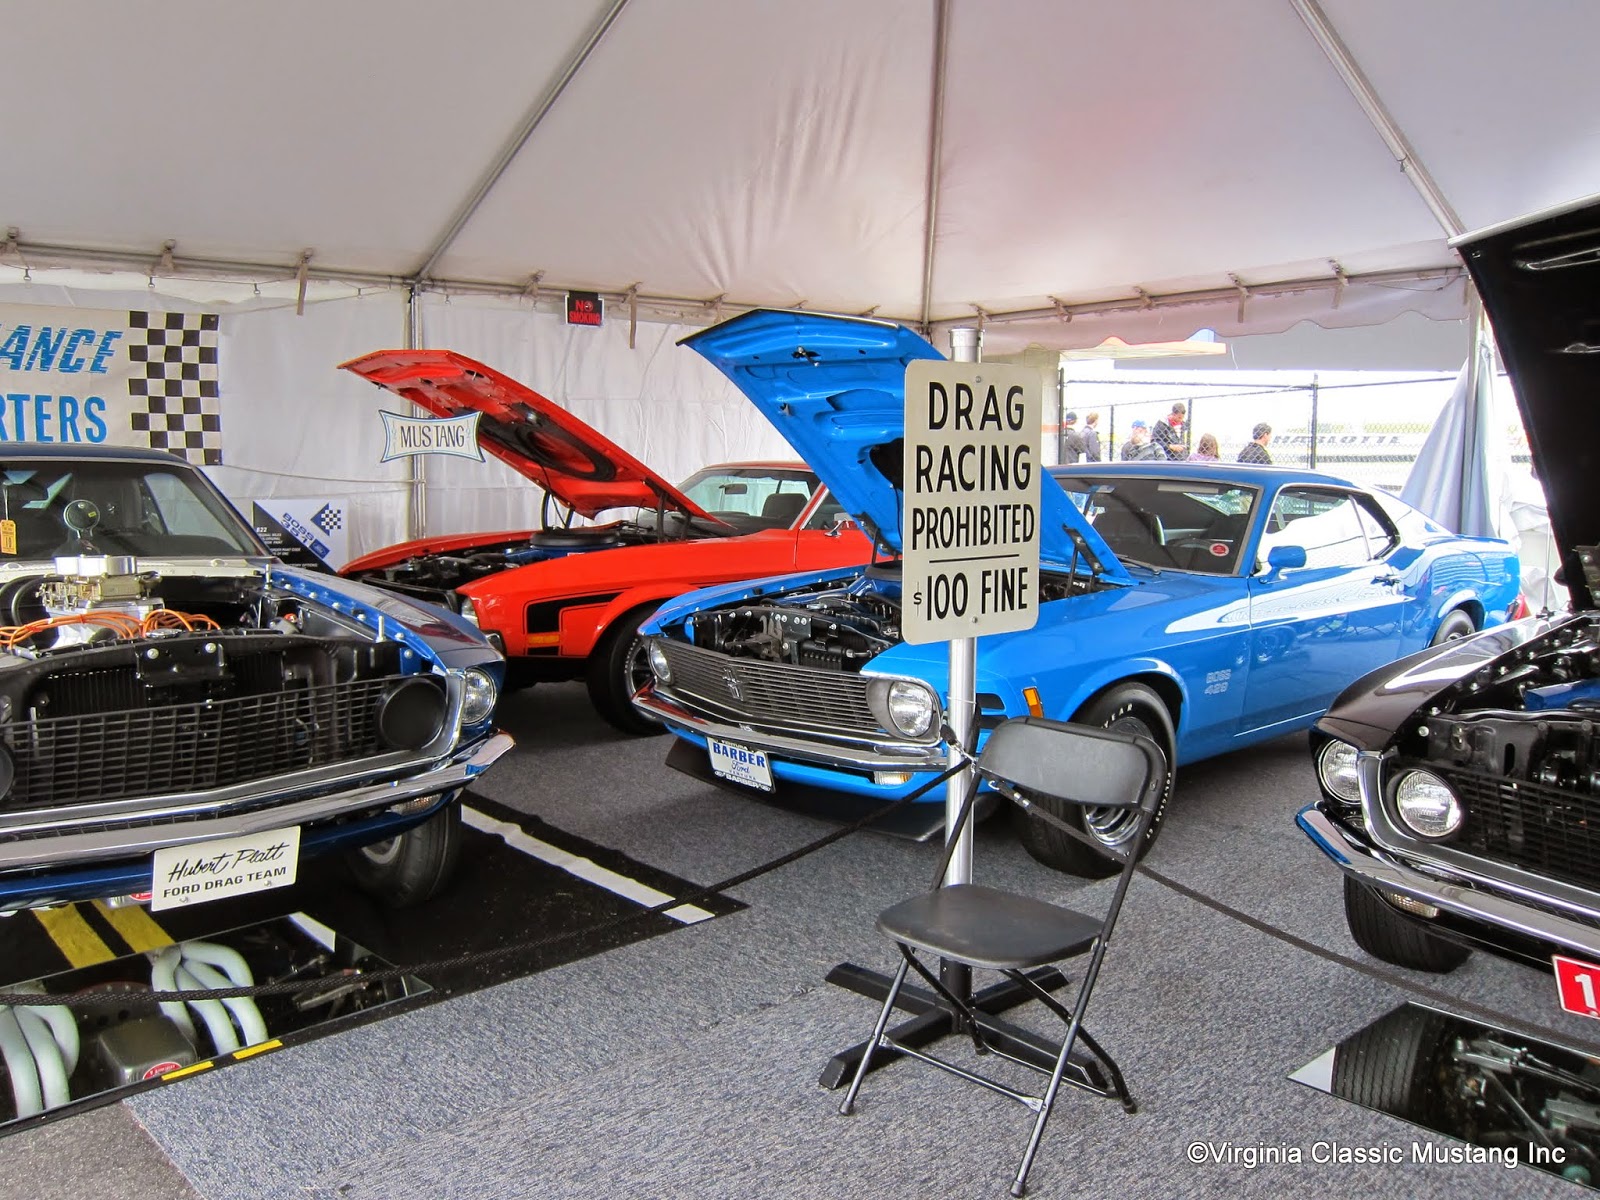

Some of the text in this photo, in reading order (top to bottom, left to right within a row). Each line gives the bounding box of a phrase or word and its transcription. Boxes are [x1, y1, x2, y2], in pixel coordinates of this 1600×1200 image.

[0, 324, 123, 374] ANCE
[928, 381, 1025, 431] DRAG
[400, 425, 465, 448] MUSTANG
[915, 444, 1032, 494] RACING
[282, 512, 315, 541] BOSS
[912, 503, 1035, 550] PROHIBITED
[913, 567, 1028, 621] $100 FINE
[713, 743, 765, 767] BARBER
[732, 760, 750, 773] Ford
[163, 883, 201, 899] FORD
[204, 875, 244, 891] DRAG
[246, 866, 287, 883] TEAM
[168, 841, 291, 883] Hubert Platt
